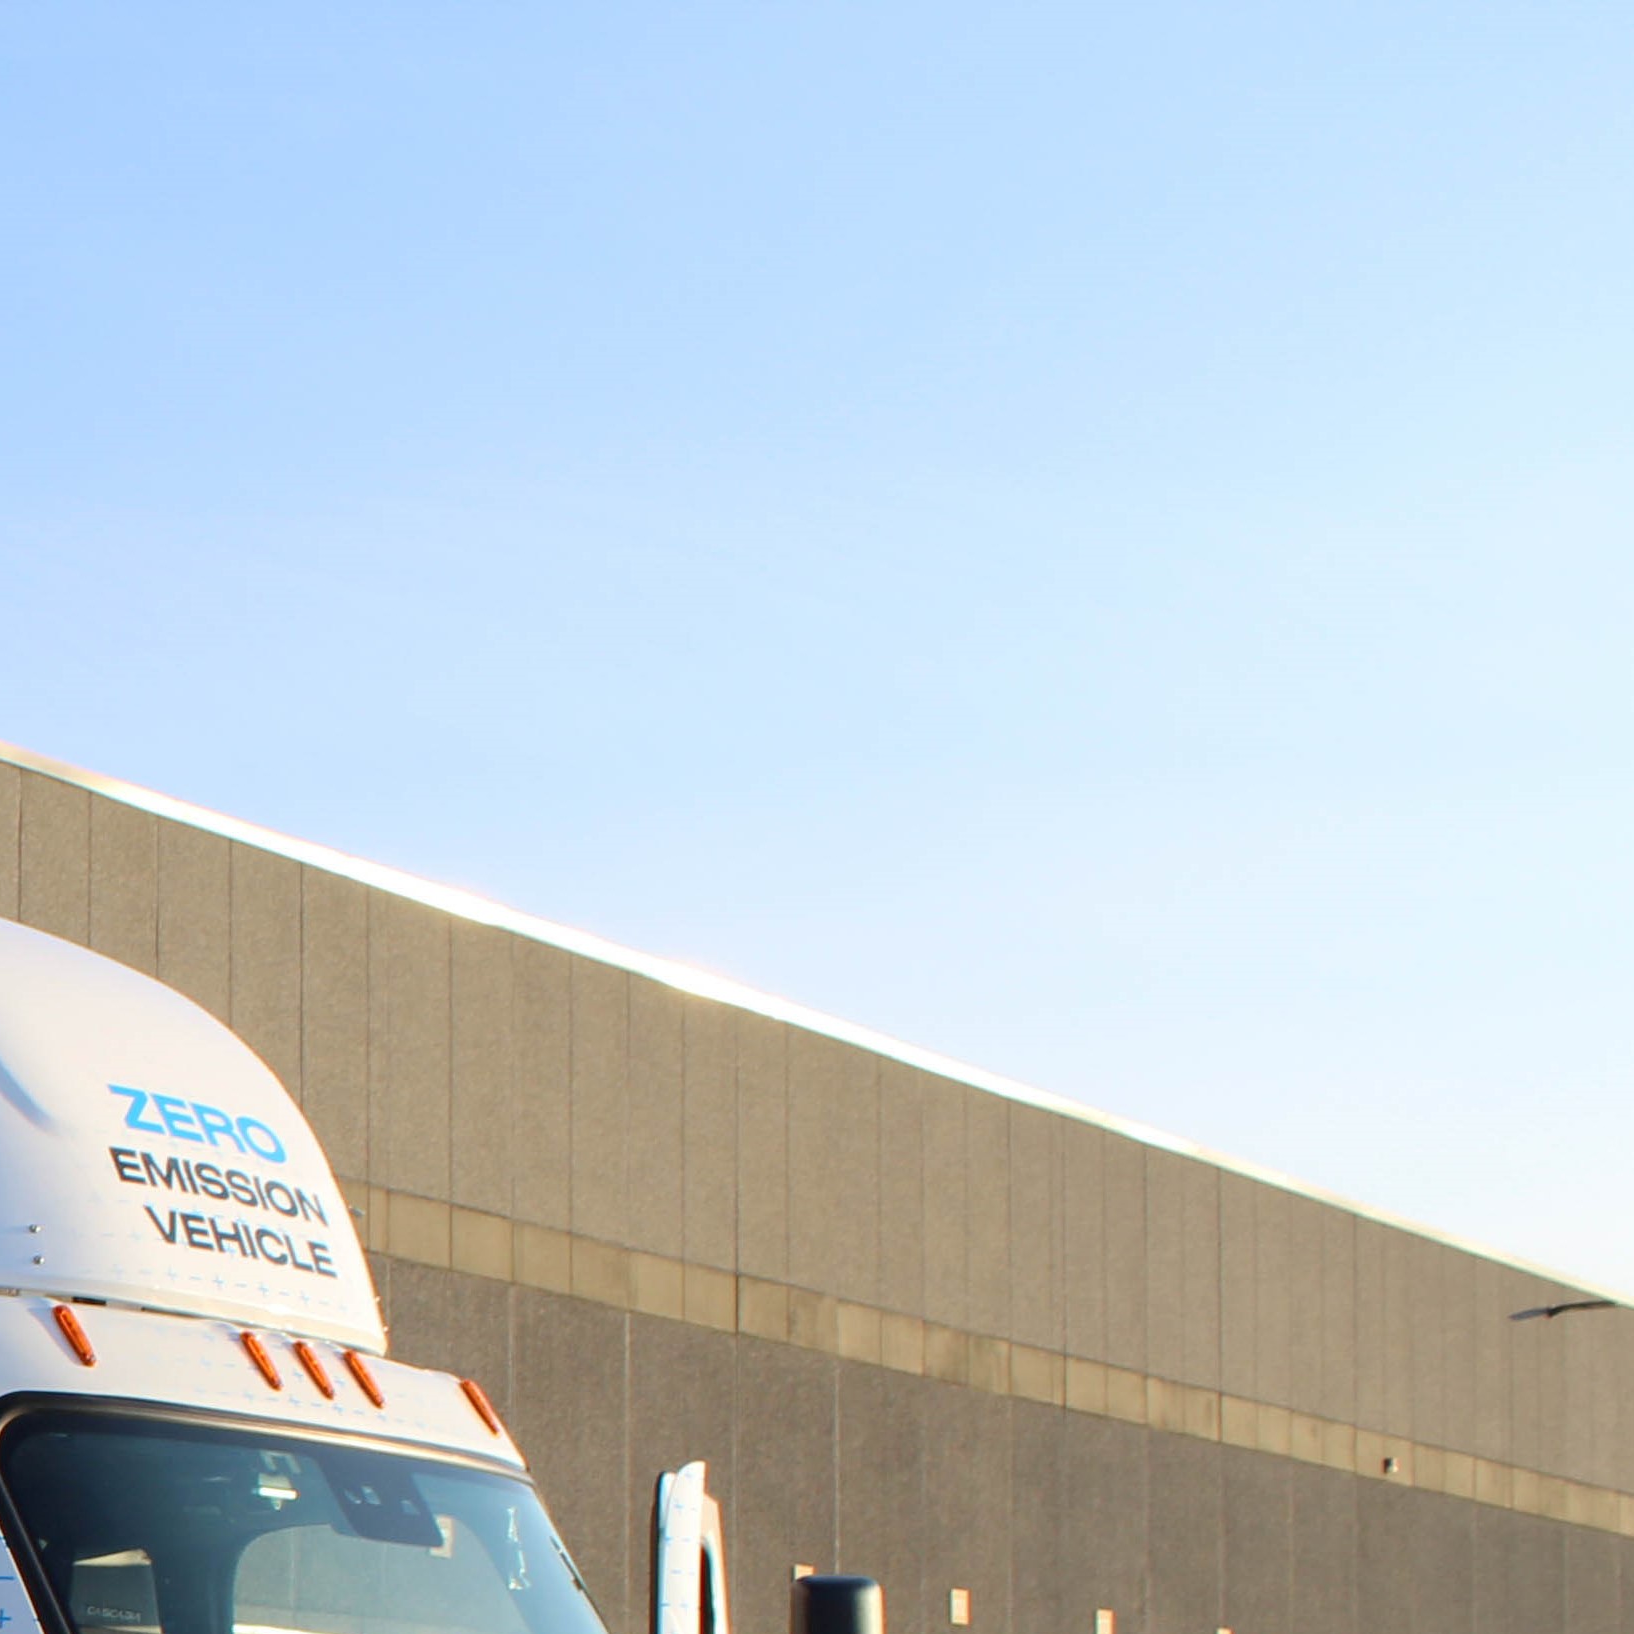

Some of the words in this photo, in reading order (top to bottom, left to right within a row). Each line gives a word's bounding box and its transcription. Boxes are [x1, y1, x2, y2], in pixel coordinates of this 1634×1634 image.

[107, 1084, 287, 1163] ZERO
[109, 1147, 330, 1227] EMISSION
[144, 1205, 338, 1278] VEHICLE
